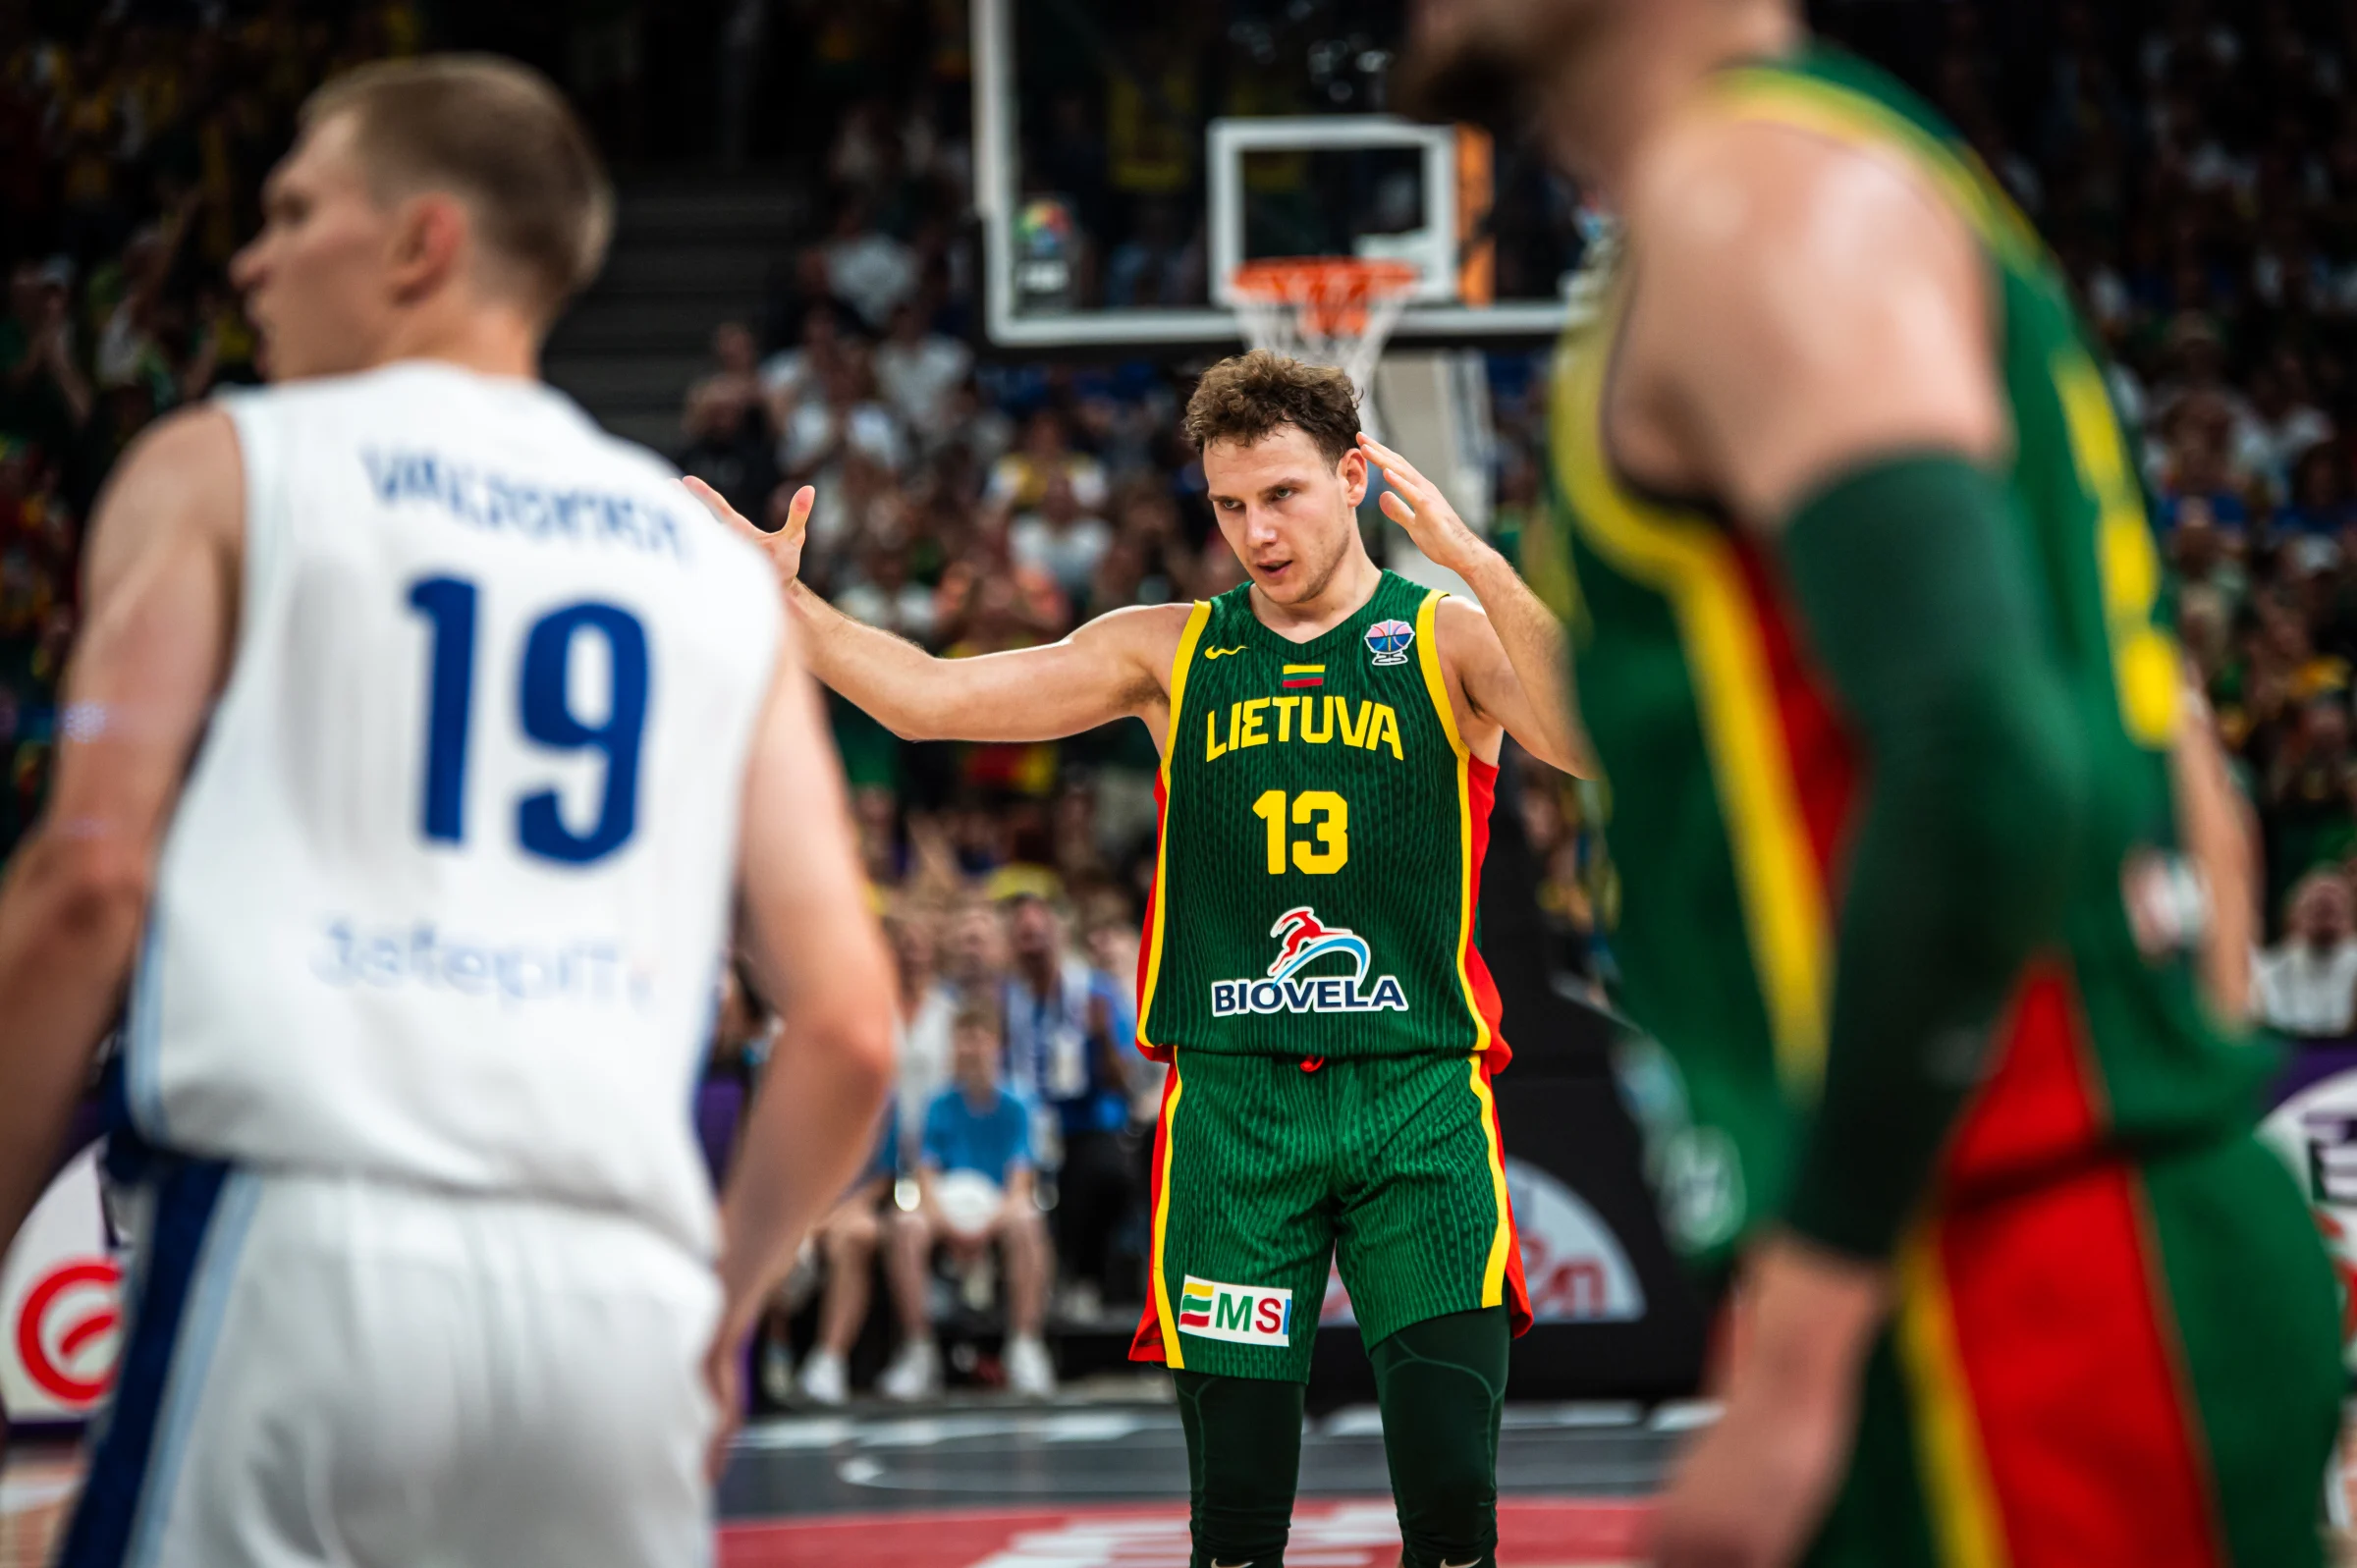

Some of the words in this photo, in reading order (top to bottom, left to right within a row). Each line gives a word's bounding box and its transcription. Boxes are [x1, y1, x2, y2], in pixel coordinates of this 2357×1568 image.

[405, 572, 649, 866] 19
[1206, 696, 1404, 763] LIETUVA
[1252, 789, 1348, 875] 13
[1212, 976, 1406, 1015] BIOVELA
